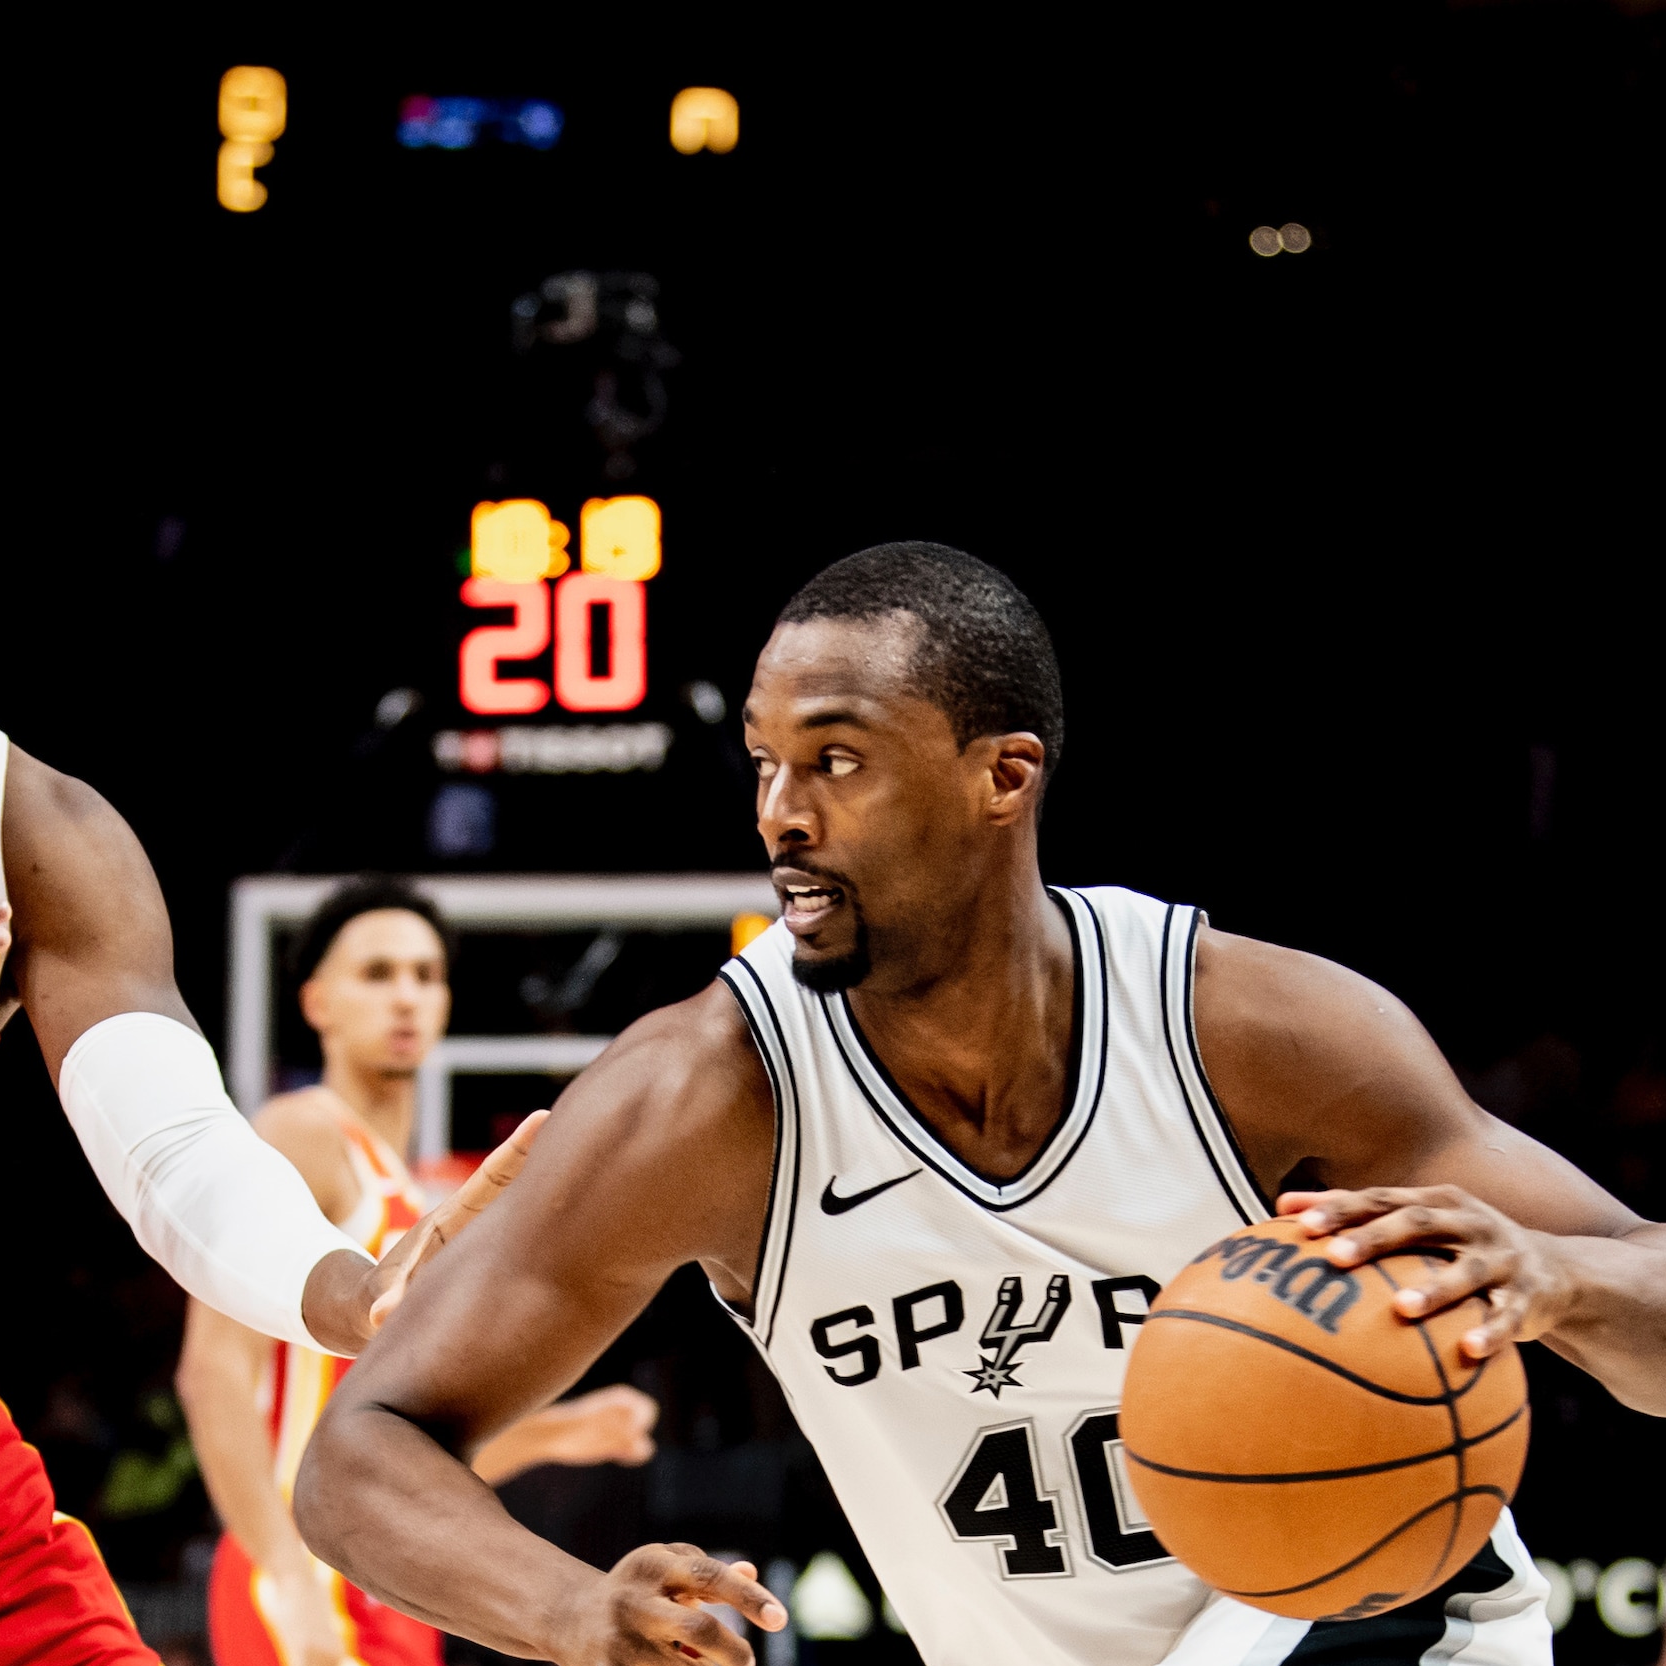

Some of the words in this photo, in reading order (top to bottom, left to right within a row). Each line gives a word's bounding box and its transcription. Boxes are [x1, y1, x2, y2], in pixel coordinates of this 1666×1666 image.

[459, 572, 647, 715] 20
[810, 1274, 1161, 1399] SPUR
[935, 1405, 1180, 1580] 40
